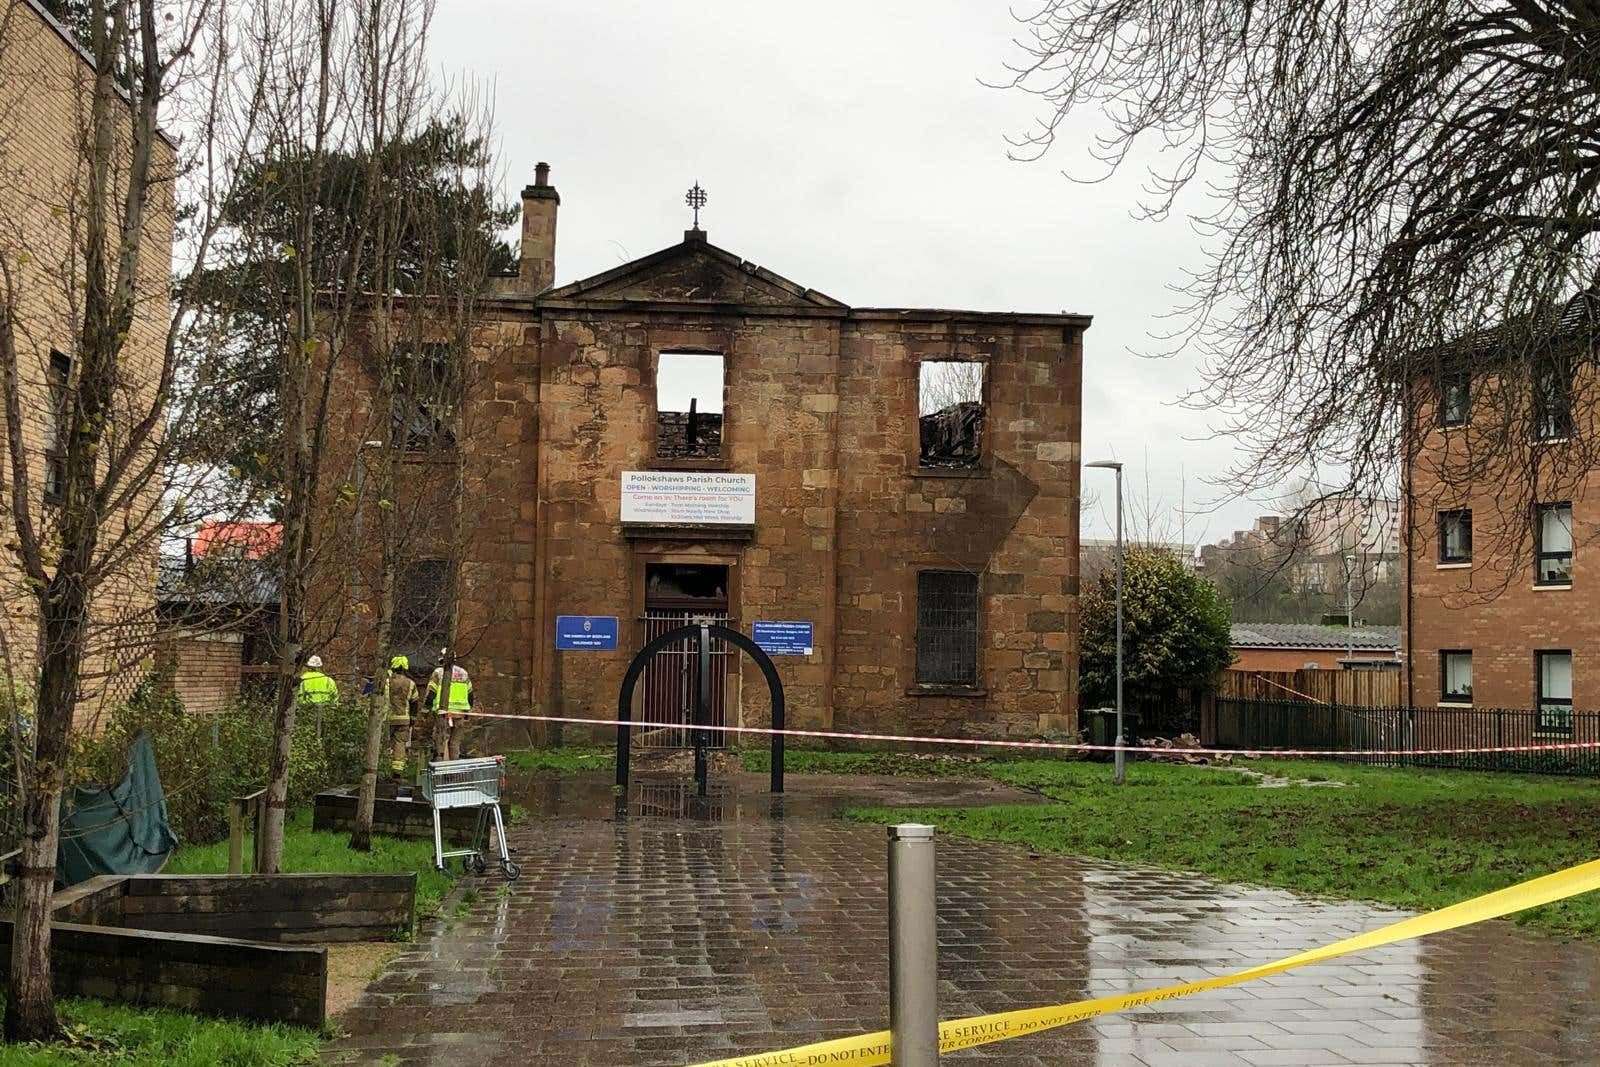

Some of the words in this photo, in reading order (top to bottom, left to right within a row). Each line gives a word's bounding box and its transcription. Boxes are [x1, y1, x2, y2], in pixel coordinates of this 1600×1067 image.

[631, 475, 684, 483] Pollokshaws
[1122, 997, 1151, 1008] FIRE
[955, 1021, 1011, 1038] SERVICE
[958, 1032, 1009, 1047] CORDON
[1019, 1021, 1038, 1031] DO
[1039, 1016, 1064, 1026] NOT
[1064, 1010, 1102, 1022] ENTER
[807, 1054, 827, 1066] DO
[830, 1049, 856, 1062] NOT
[859, 1044, 891, 1058] ENTE
